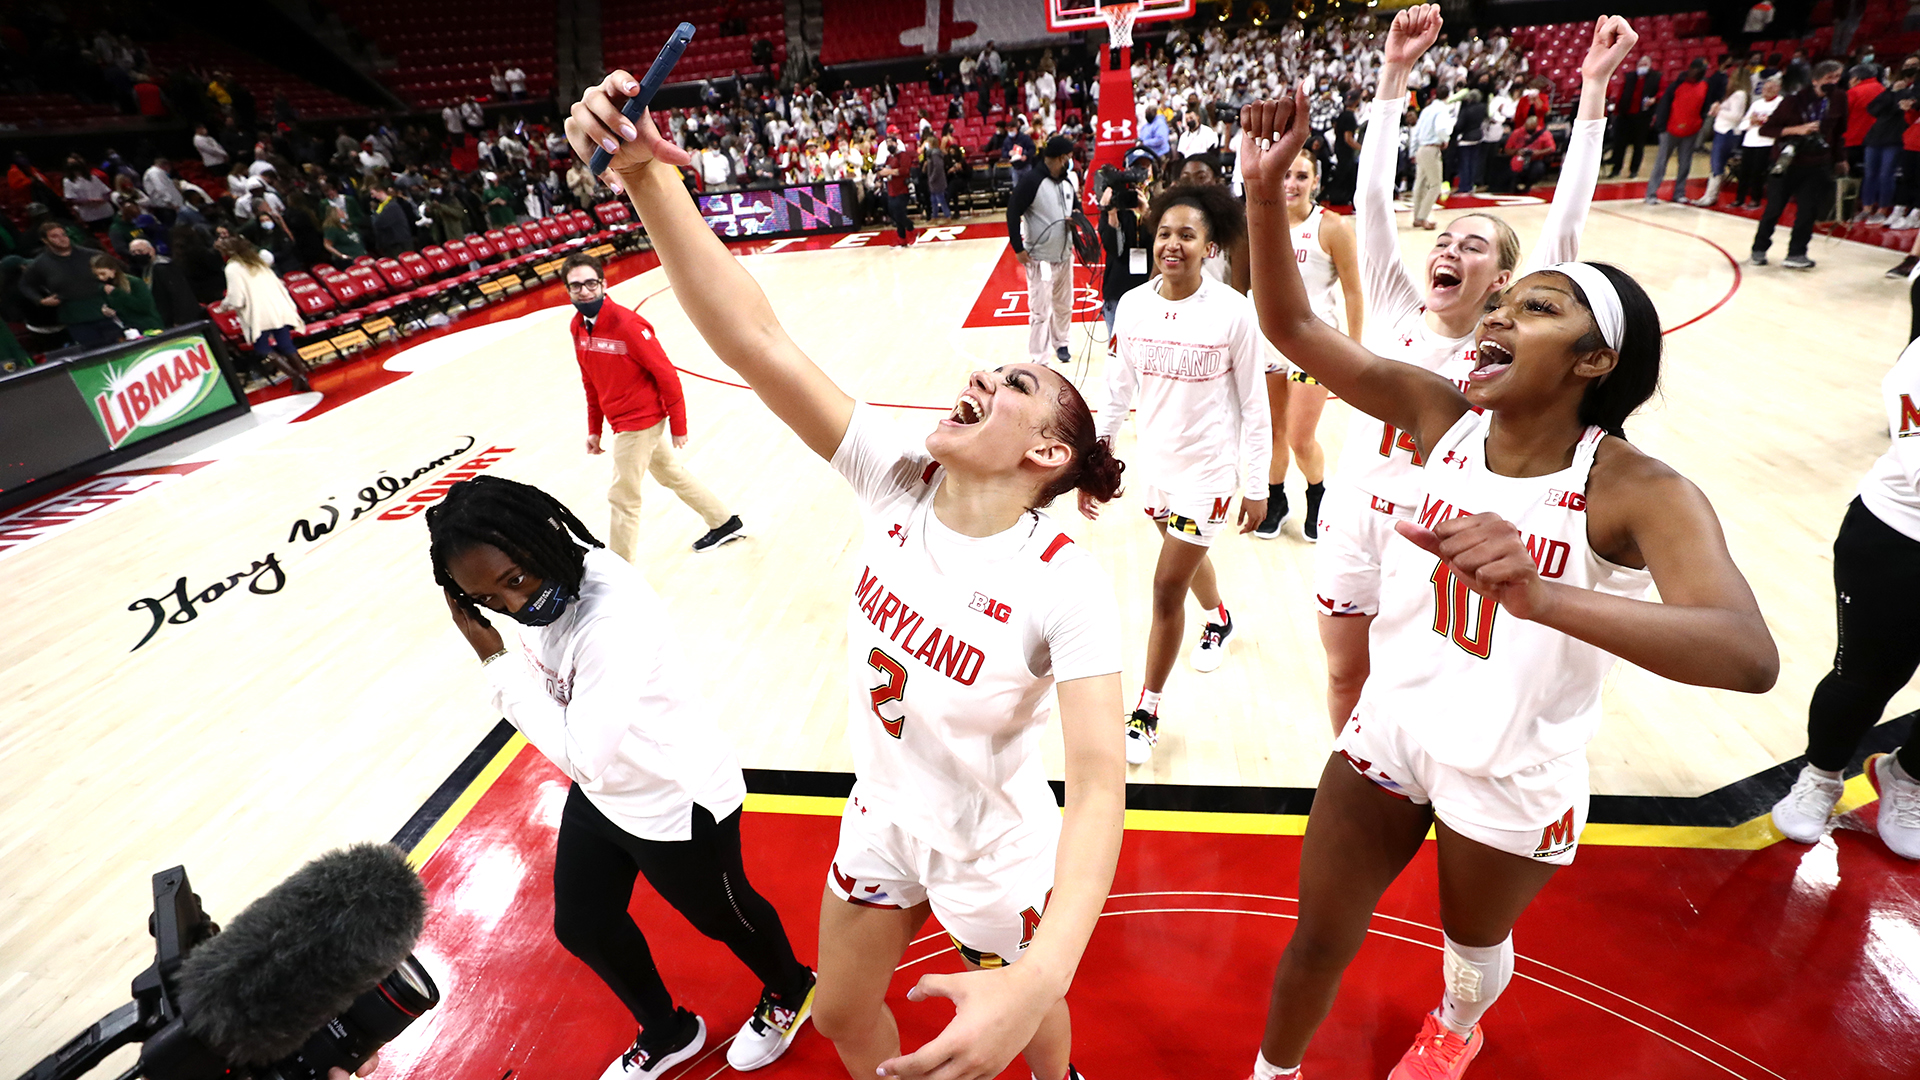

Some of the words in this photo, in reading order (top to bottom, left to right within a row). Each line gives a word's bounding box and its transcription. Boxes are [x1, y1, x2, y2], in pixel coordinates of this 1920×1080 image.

[96, 343, 212, 446] LIBMAN
[376, 446, 516, 521] COURT
[1208, 496, 1232, 520] M
[855, 565, 986, 686] MARYLAND
[1430, 558, 1499, 660] 10
[868, 647, 908, 739] 2
[1535, 805, 1574, 851] M
